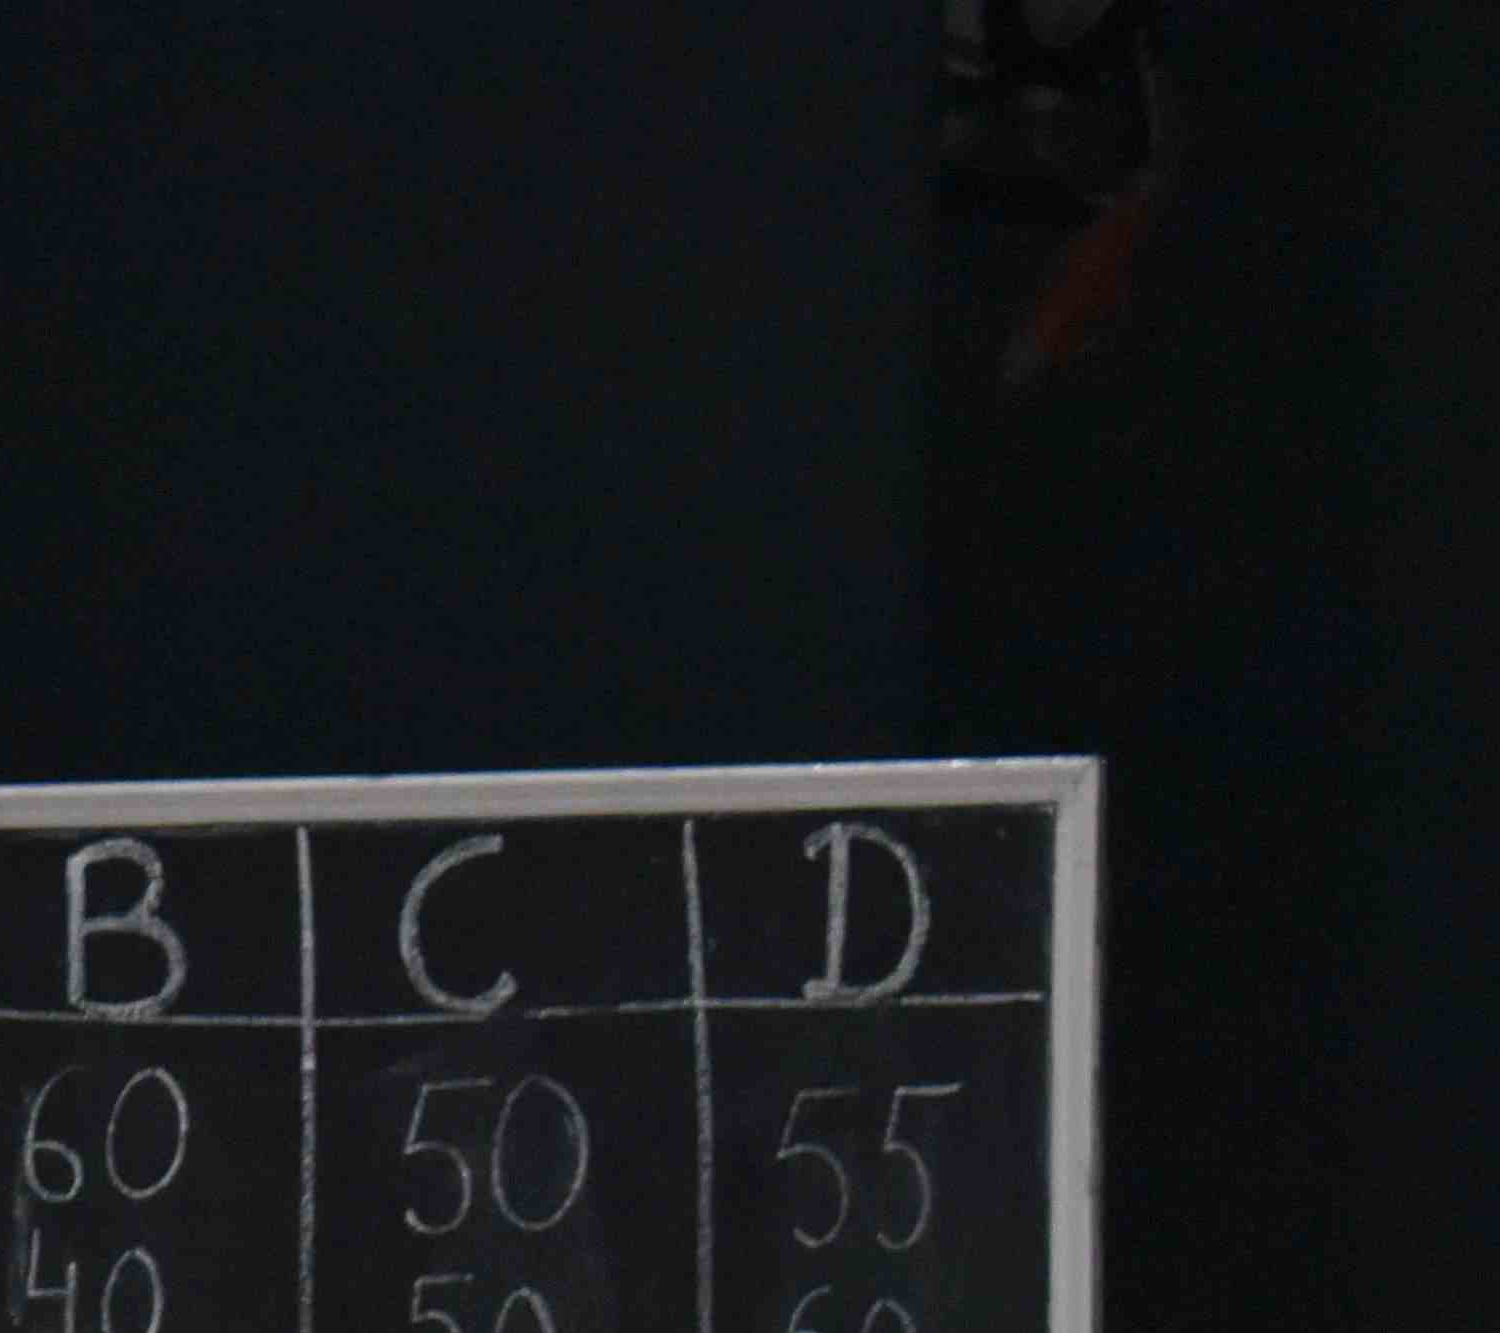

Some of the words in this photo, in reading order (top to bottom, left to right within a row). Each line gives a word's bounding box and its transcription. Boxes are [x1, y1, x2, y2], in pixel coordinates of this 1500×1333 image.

[66, 837, 188, 1019] B
[399, 832, 518, 1012] C
[802, 820, 931, 1006] D
[25, 1064, 189, 1202] 60
[402, 1073, 589, 1235] 50
[776, 1080, 966, 1250] 55
